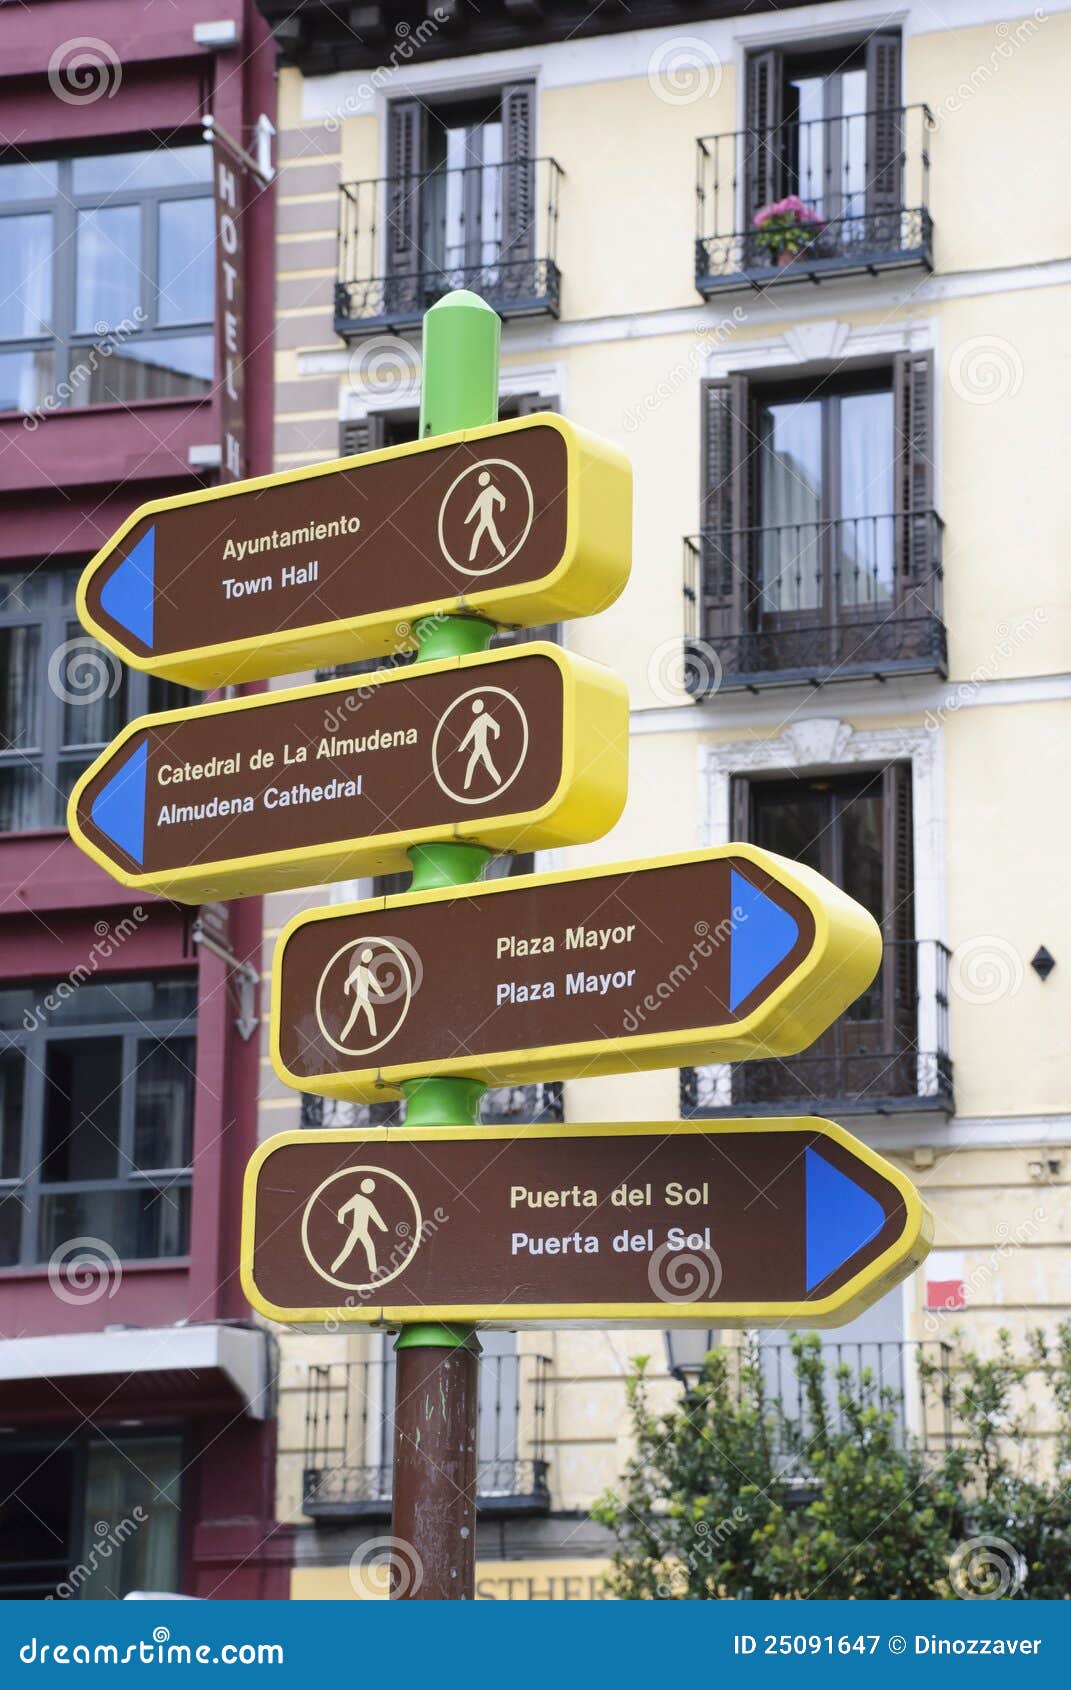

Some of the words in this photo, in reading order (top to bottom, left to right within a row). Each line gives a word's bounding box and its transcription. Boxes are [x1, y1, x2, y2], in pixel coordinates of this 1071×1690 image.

[218, 163, 238, 401] HOTEL
[222, 515, 361, 561] Ayuntamiento
[222, 575, 273, 600] Town
[281, 560, 319, 588] Hall
[157, 752, 241, 786] Catedral
[249, 749, 275, 770] de
[283, 744, 307, 765] La
[316, 728, 418, 760] Almudena
[157, 796, 254, 826] Almudena
[263, 774, 363, 809] Cathedral
[496, 935, 555, 960] Plaza
[565, 924, 636, 951] Mayor
[496, 981, 555, 1006] Plaza
[565, 969, 636, 996] Mayor
[510, 1185, 598, 1209] Puerta
[610, 1183, 652, 1207] del
[664, 1182, 709, 1206] Sol
[511, 1232, 600, 1256] Puerta
[612, 1229, 653, 1253] del
[666, 1227, 711, 1252] Sol
